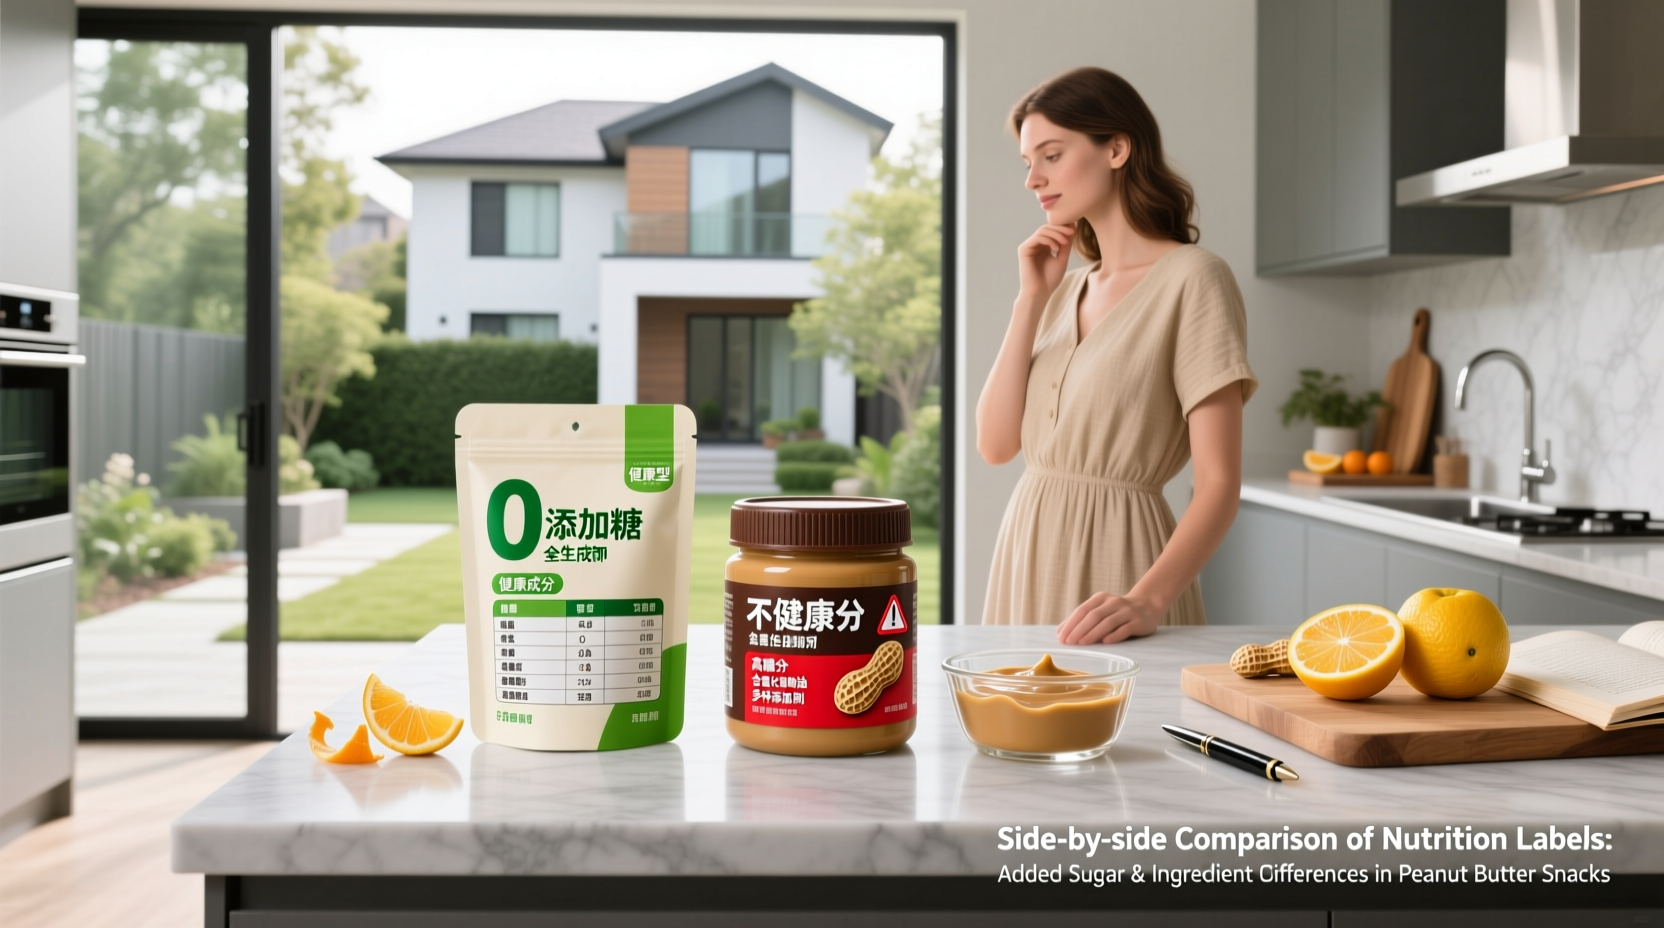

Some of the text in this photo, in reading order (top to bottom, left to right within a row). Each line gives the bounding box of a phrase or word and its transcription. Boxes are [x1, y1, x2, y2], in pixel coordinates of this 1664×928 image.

[545, 507, 643, 540] 添加糖
[746, 597, 865, 632] 不健康分
